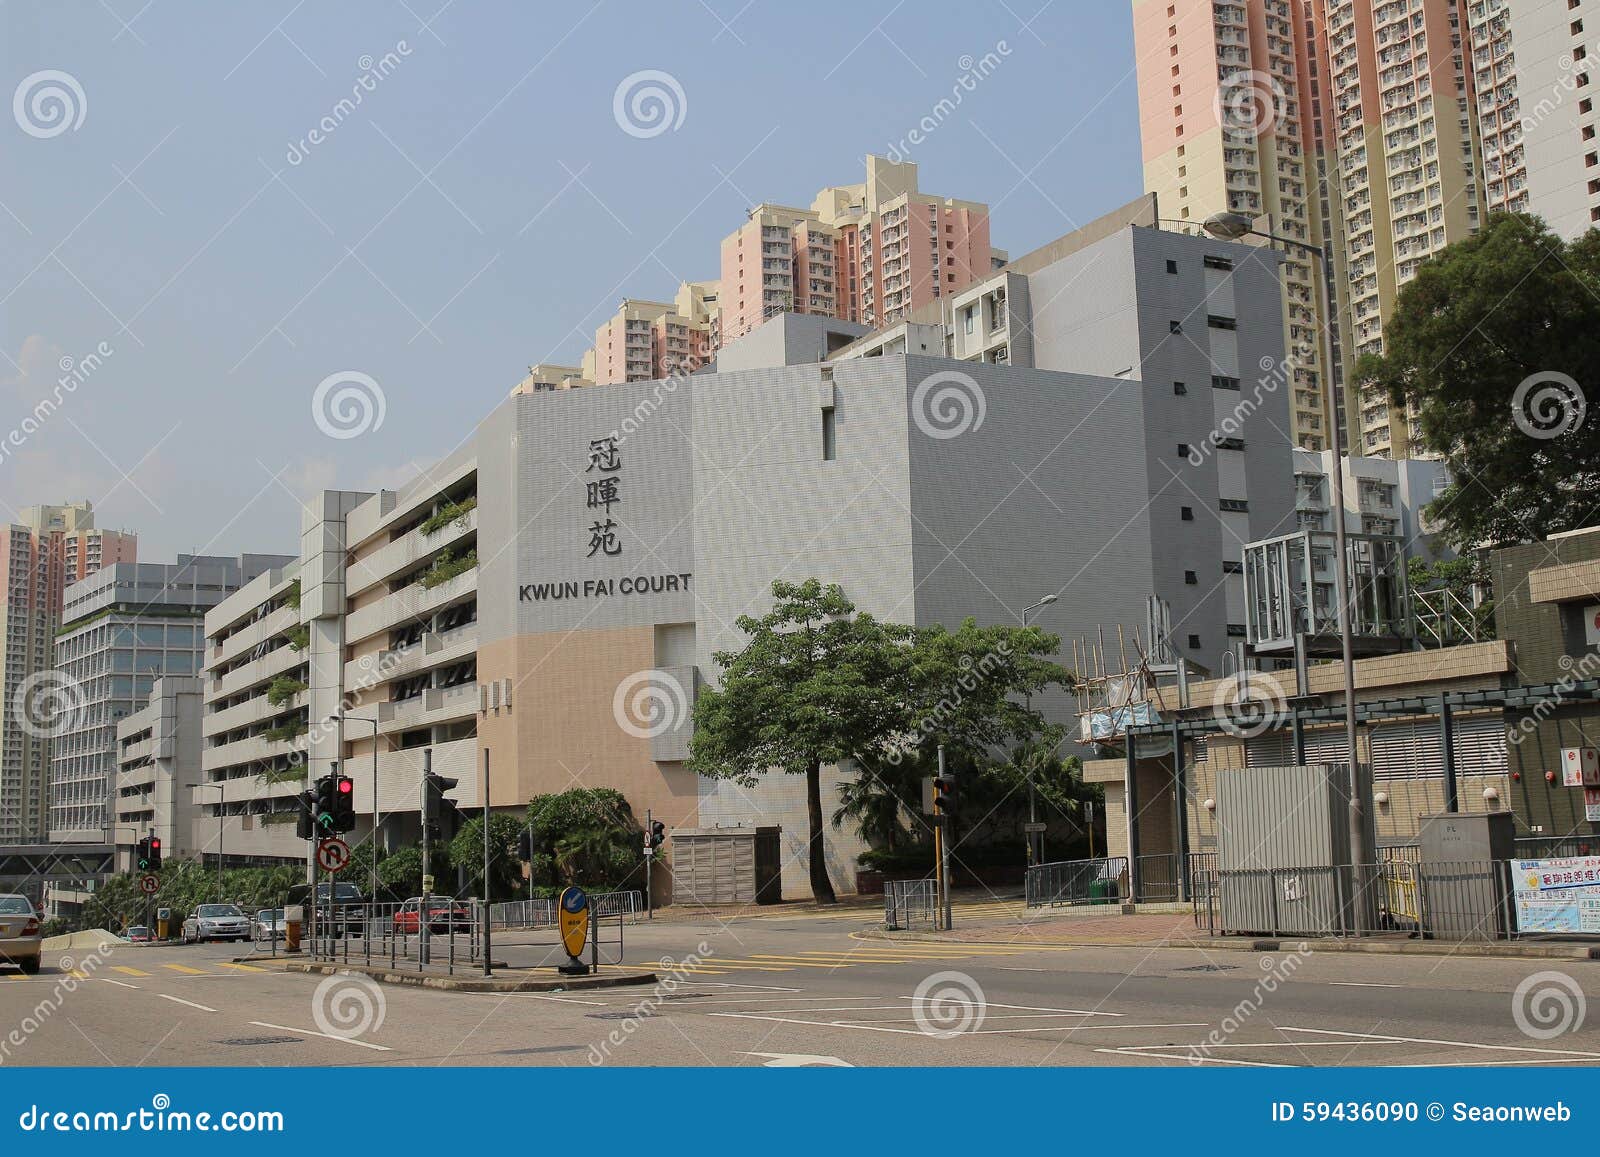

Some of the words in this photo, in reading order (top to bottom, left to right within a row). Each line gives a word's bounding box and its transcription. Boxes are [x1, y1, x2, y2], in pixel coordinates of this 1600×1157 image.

[585, 435, 622, 558] 冠暉苑
[519, 582, 578, 601] KWUN
[583, 579, 614, 597] FAI
[619, 573, 692, 595] COURT
